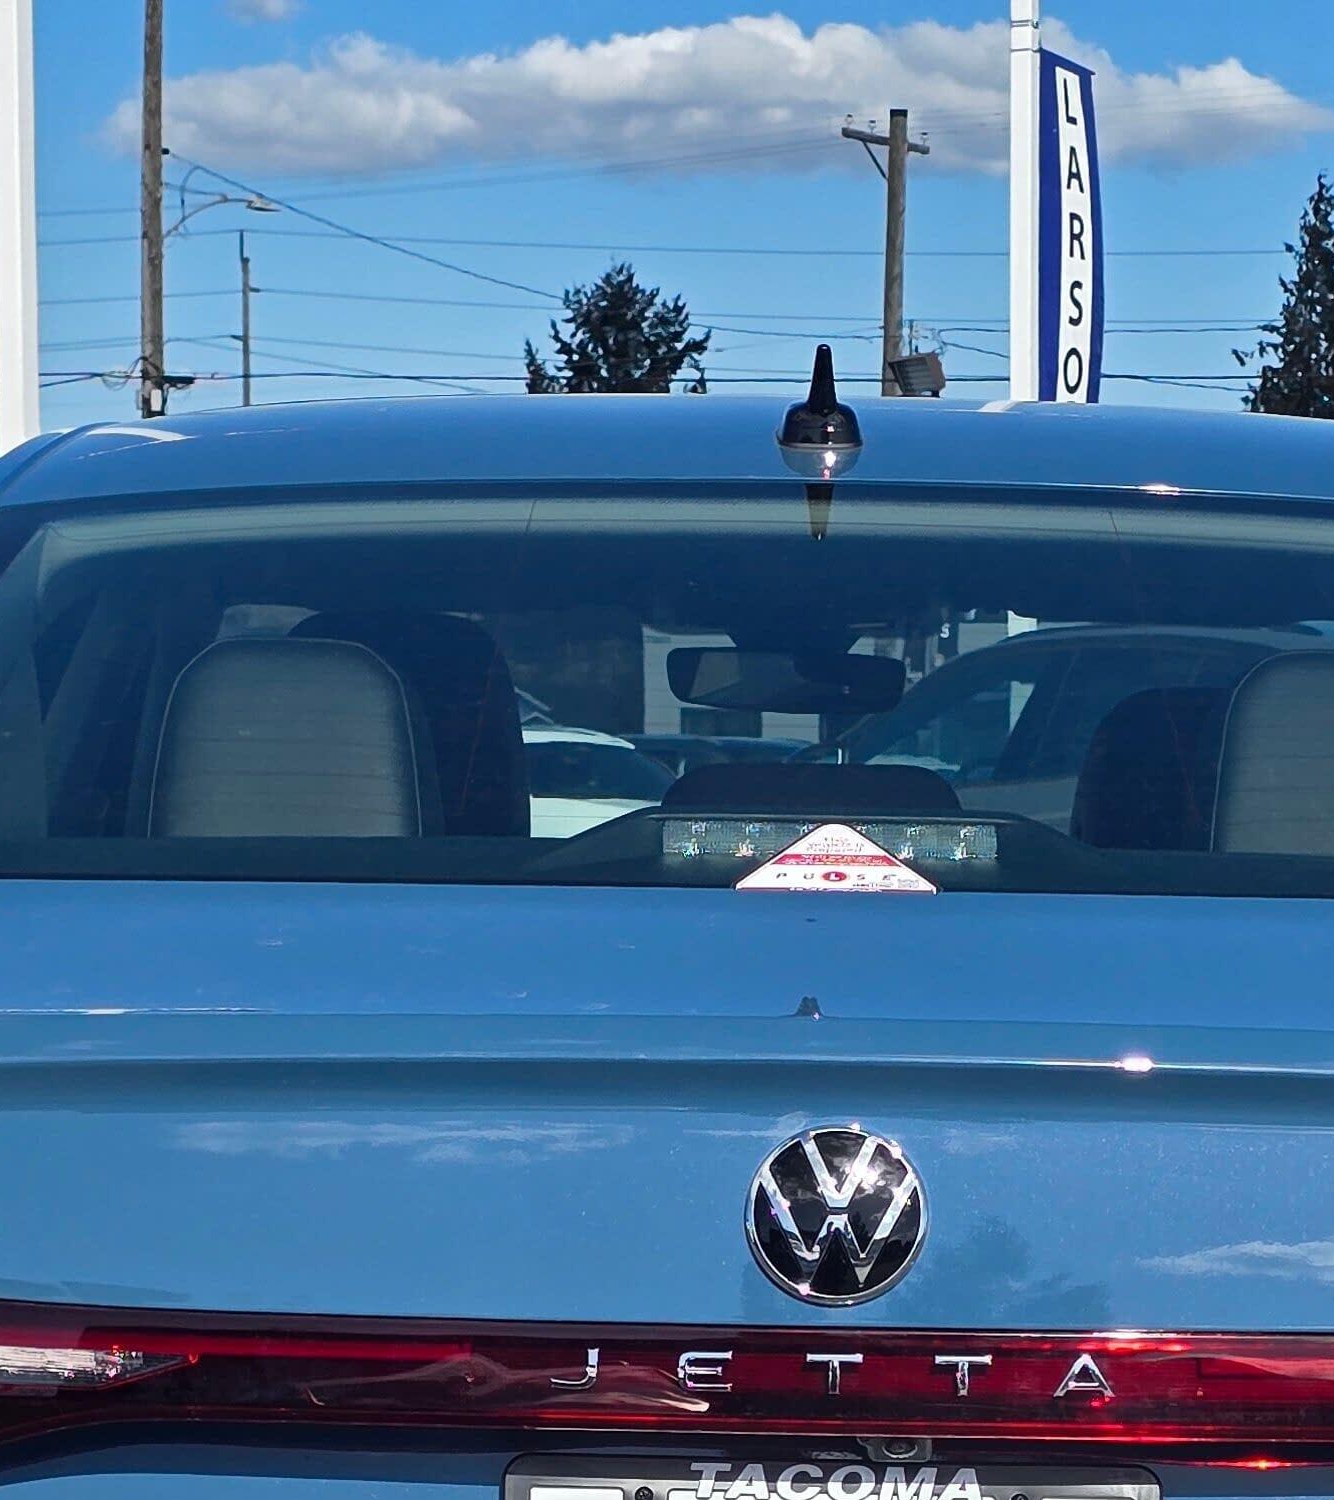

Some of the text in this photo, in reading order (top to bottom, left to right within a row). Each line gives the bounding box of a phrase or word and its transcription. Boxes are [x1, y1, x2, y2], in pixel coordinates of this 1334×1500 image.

[1063, 77, 1085, 402] LARSO
[776, 871, 896, 881] PULSE
[550, 1347, 1116, 1398] JETTA
